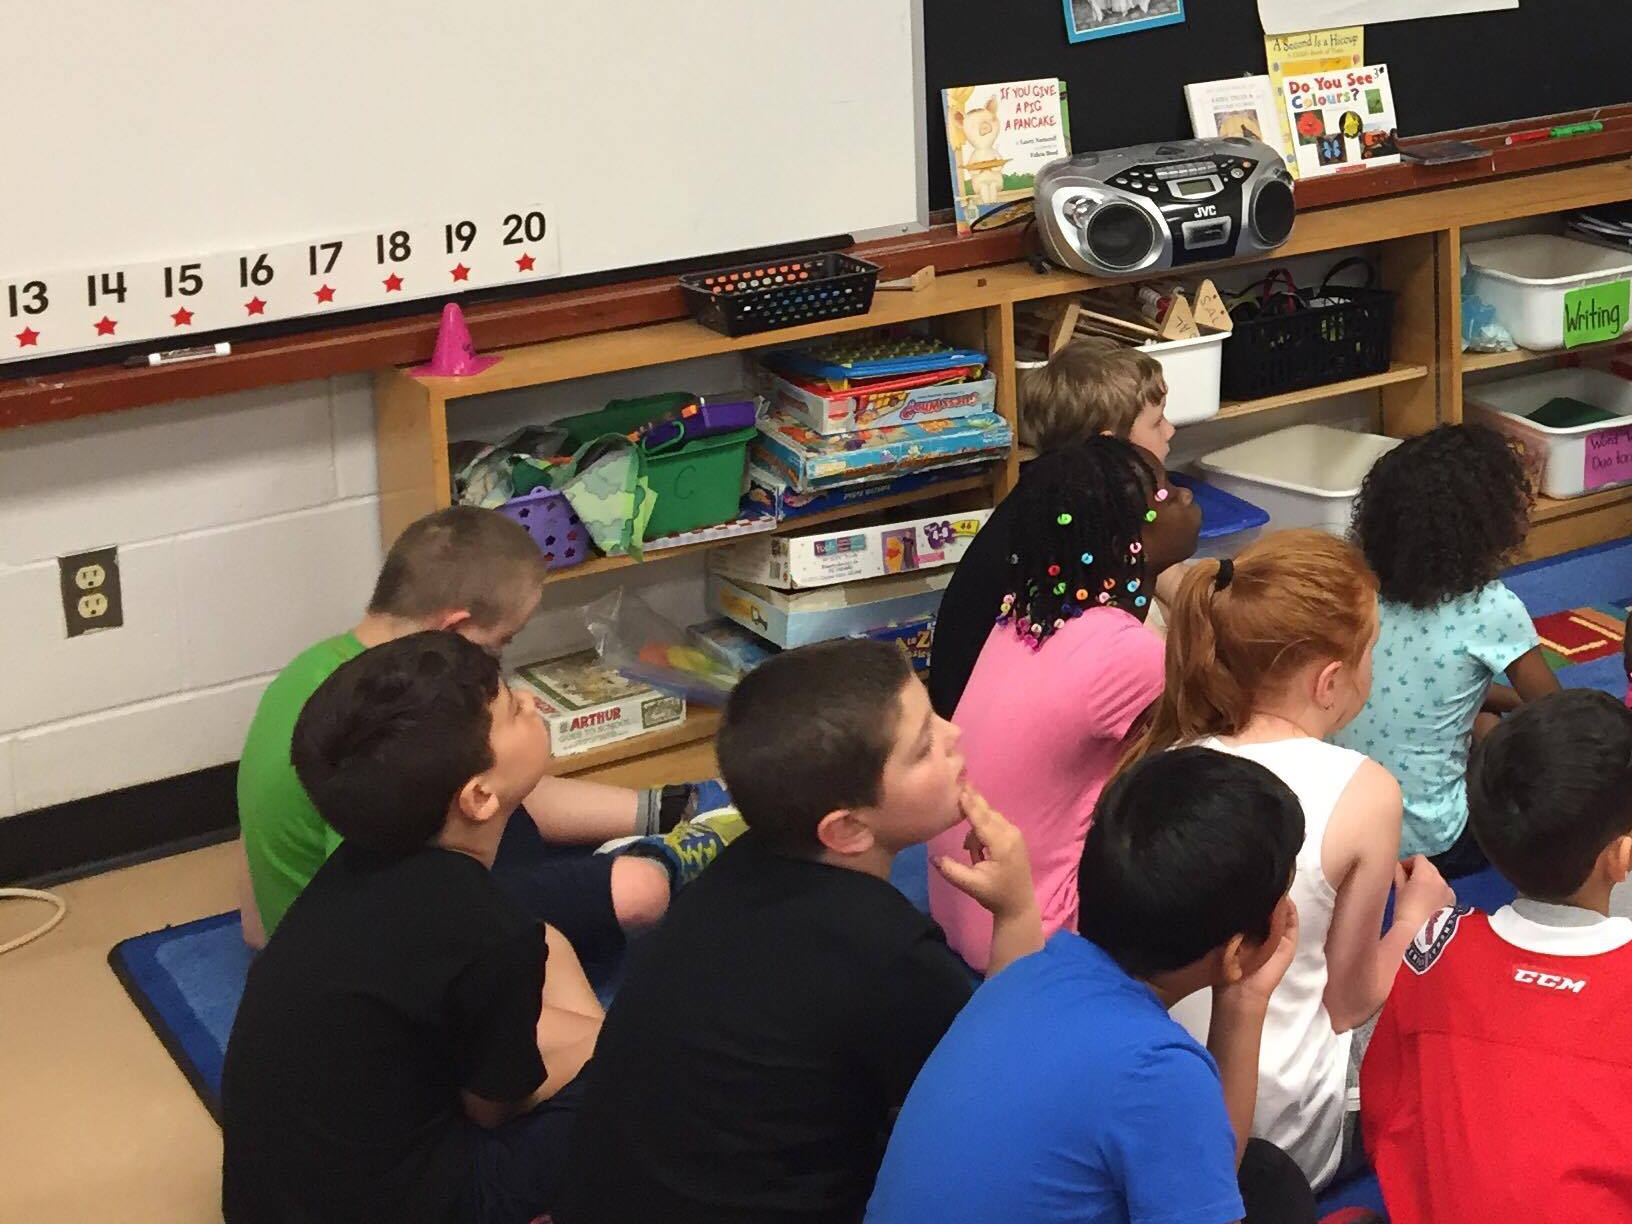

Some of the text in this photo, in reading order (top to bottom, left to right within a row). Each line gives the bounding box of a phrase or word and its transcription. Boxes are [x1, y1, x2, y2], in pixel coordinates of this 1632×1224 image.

[1013, 85, 1056, 98] YOU GIVE
[1289, 73, 1372, 94] Do You See
[1024, 100, 1041, 113] PIG
[1292, 88, 1359, 108] Colours?
[1014, 115, 1056, 130] PANCAKE
[1194, 205, 1216, 218] JVC
[376, 211, 547, 264] 18 20
[1565, 299, 1620, 334] Writing
[570, 707, 621, 731] ARTHUR
[1514, 968, 1587, 993] CCM
